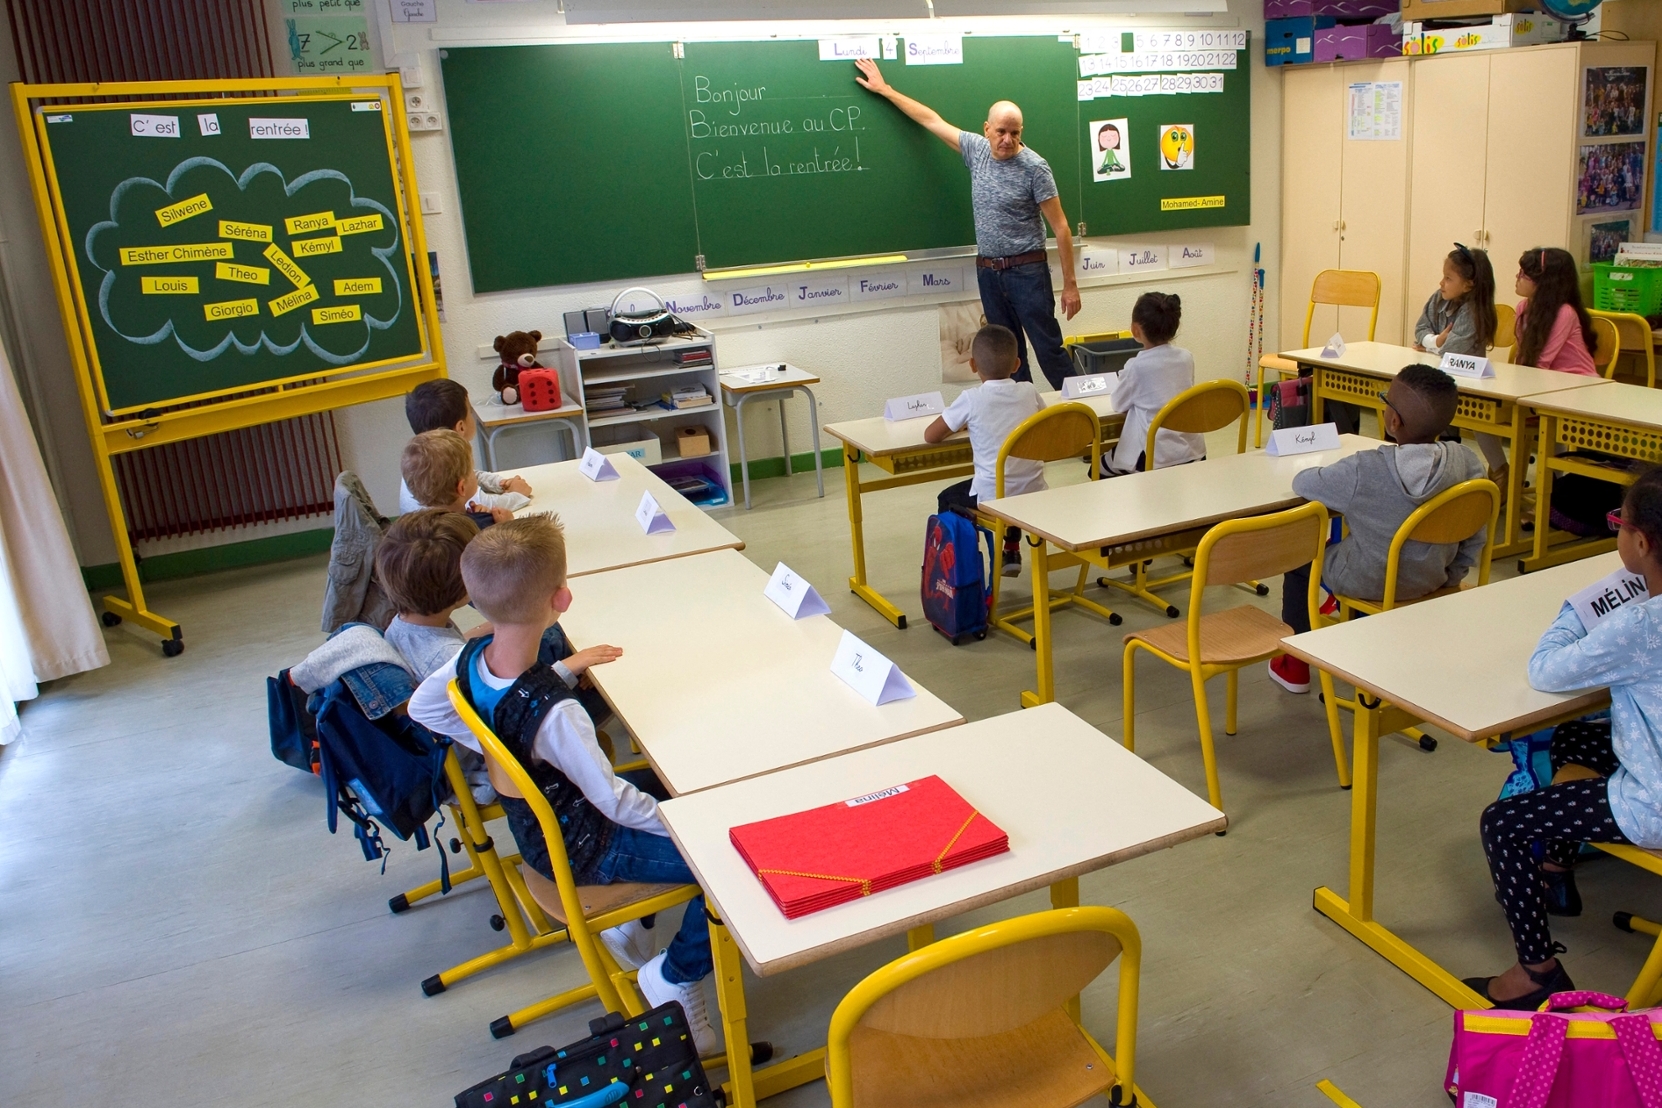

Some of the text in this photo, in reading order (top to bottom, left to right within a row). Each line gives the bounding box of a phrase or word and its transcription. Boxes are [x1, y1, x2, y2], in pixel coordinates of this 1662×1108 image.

[344, 0, 361, 11] que
[298, 34, 311, 50] 7
[346, 35, 358, 50] 2
[885, 41, 893, 56] 4
[1136, 35, 1144, 48] 5
[1150, 34, 1158, 47] 6
[1163, 34, 1171, 47] 7
[1175, 34, 1183, 46] 8
[1187, 34, 1195, 46] 9
[1200, 33, 1213, 46] 10
[1217, 33, 1229, 46] 11
[1232, 33, 1245, 46] 12
[833, 42, 868, 57] Lundi
[908, 42, 960, 64] Septembre
[298, 58, 364, 72] plus grand que
[1116, 57, 1128, 69] 15
[1131, 56, 1144, 68] 16
[1145, 54, 1158, 67] 17
[1160, 54, 1174, 67] 18
[1178, 54, 1190, 66] 19
[1191, 54, 1206, 67] 20
[1207, 52, 1221, 65] 21
[1222, 52, 1237, 66] 22
[1078, 76, 1223, 97] 23 24 25 26 27 28 29 30 31
[695, 75, 766, 116] Bonjour
[204, 119, 219, 133] la
[251, 122, 302, 137] rentrée
[689, 106, 866, 138] Bienvenue au CP.
[696, 150, 752, 179] C'est
[763, 146, 781, 176] la
[161, 198, 208, 224] Silwene
[225, 224, 267, 240] Séréna
[294, 216, 330, 232] Ranya
[342, 217, 378, 233] Lazhar
[128, 243, 228, 263] Esther Chimène
[300, 241, 335, 256] Kémyl
[1182, 247, 1203, 259] Août
[270, 250, 303, 284] Ledion
[1083, 258, 1106, 270] Juin
[1129, 252, 1158, 266] Juillet
[228, 267, 258, 281] Theo
[923, 274, 951, 287] Mars
[154, 279, 189, 292] Louis
[343, 281, 374, 293] Adem
[798, 284, 842, 301] Janvier
[860, 278, 900, 293] Février
[276, 289, 313, 312] Mélina
[666, 296, 721, 314] Novembre
[733, 291, 785, 307] Décembre
[210, 302, 254, 319] Giorgio
[319, 307, 354, 321] Siméo
[1450, 358, 1476, 370] RANYA
[851, 652, 864, 673] Theo
